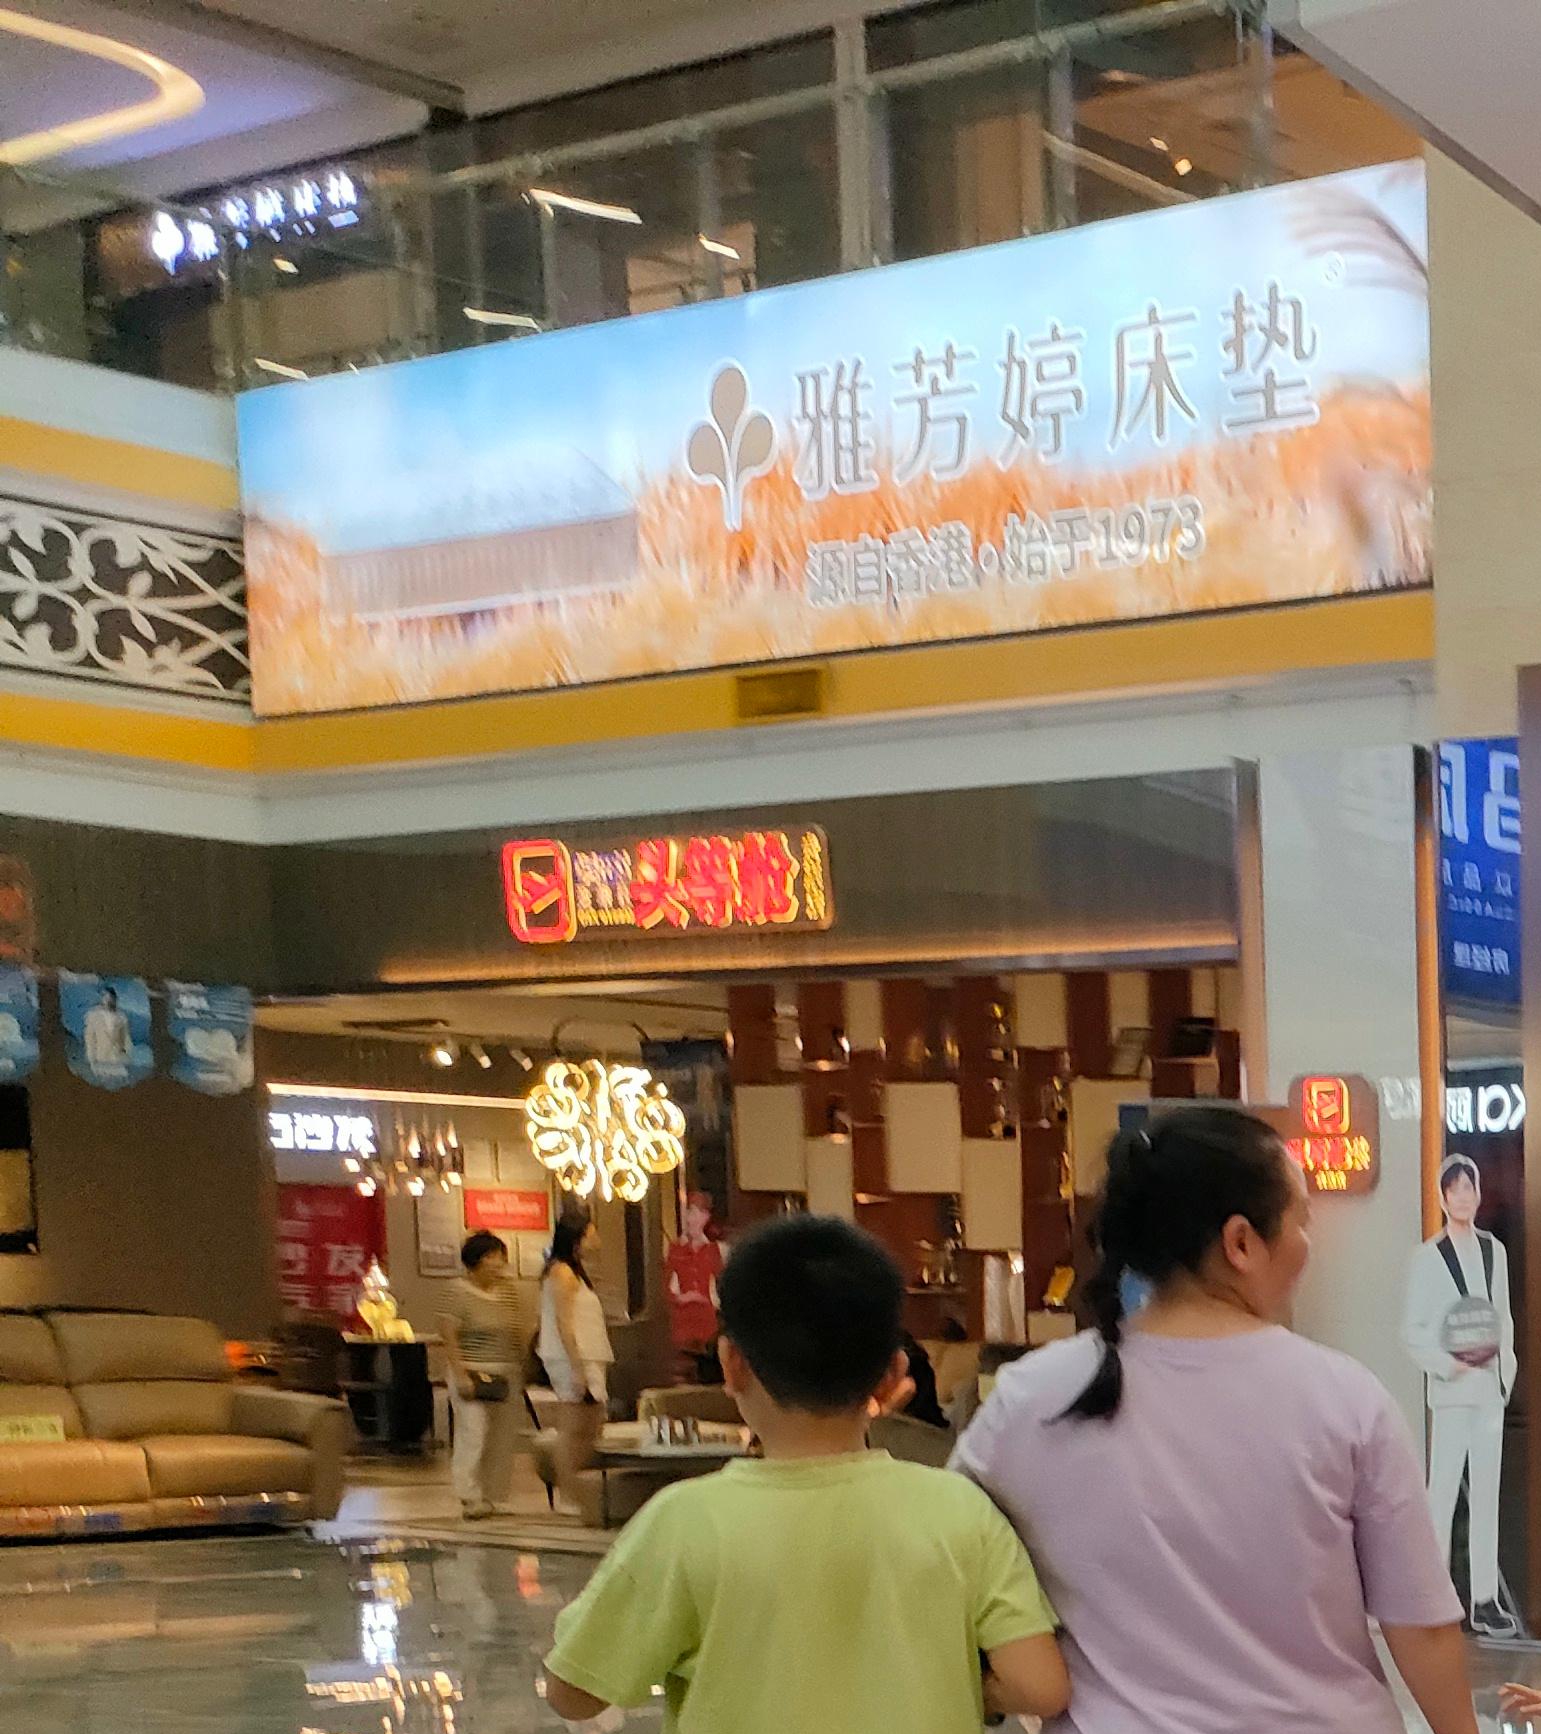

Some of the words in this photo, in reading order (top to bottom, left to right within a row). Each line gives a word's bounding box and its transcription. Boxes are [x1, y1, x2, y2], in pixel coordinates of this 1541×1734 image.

[792, 277, 1320, 501] 雅芳婷床垫
